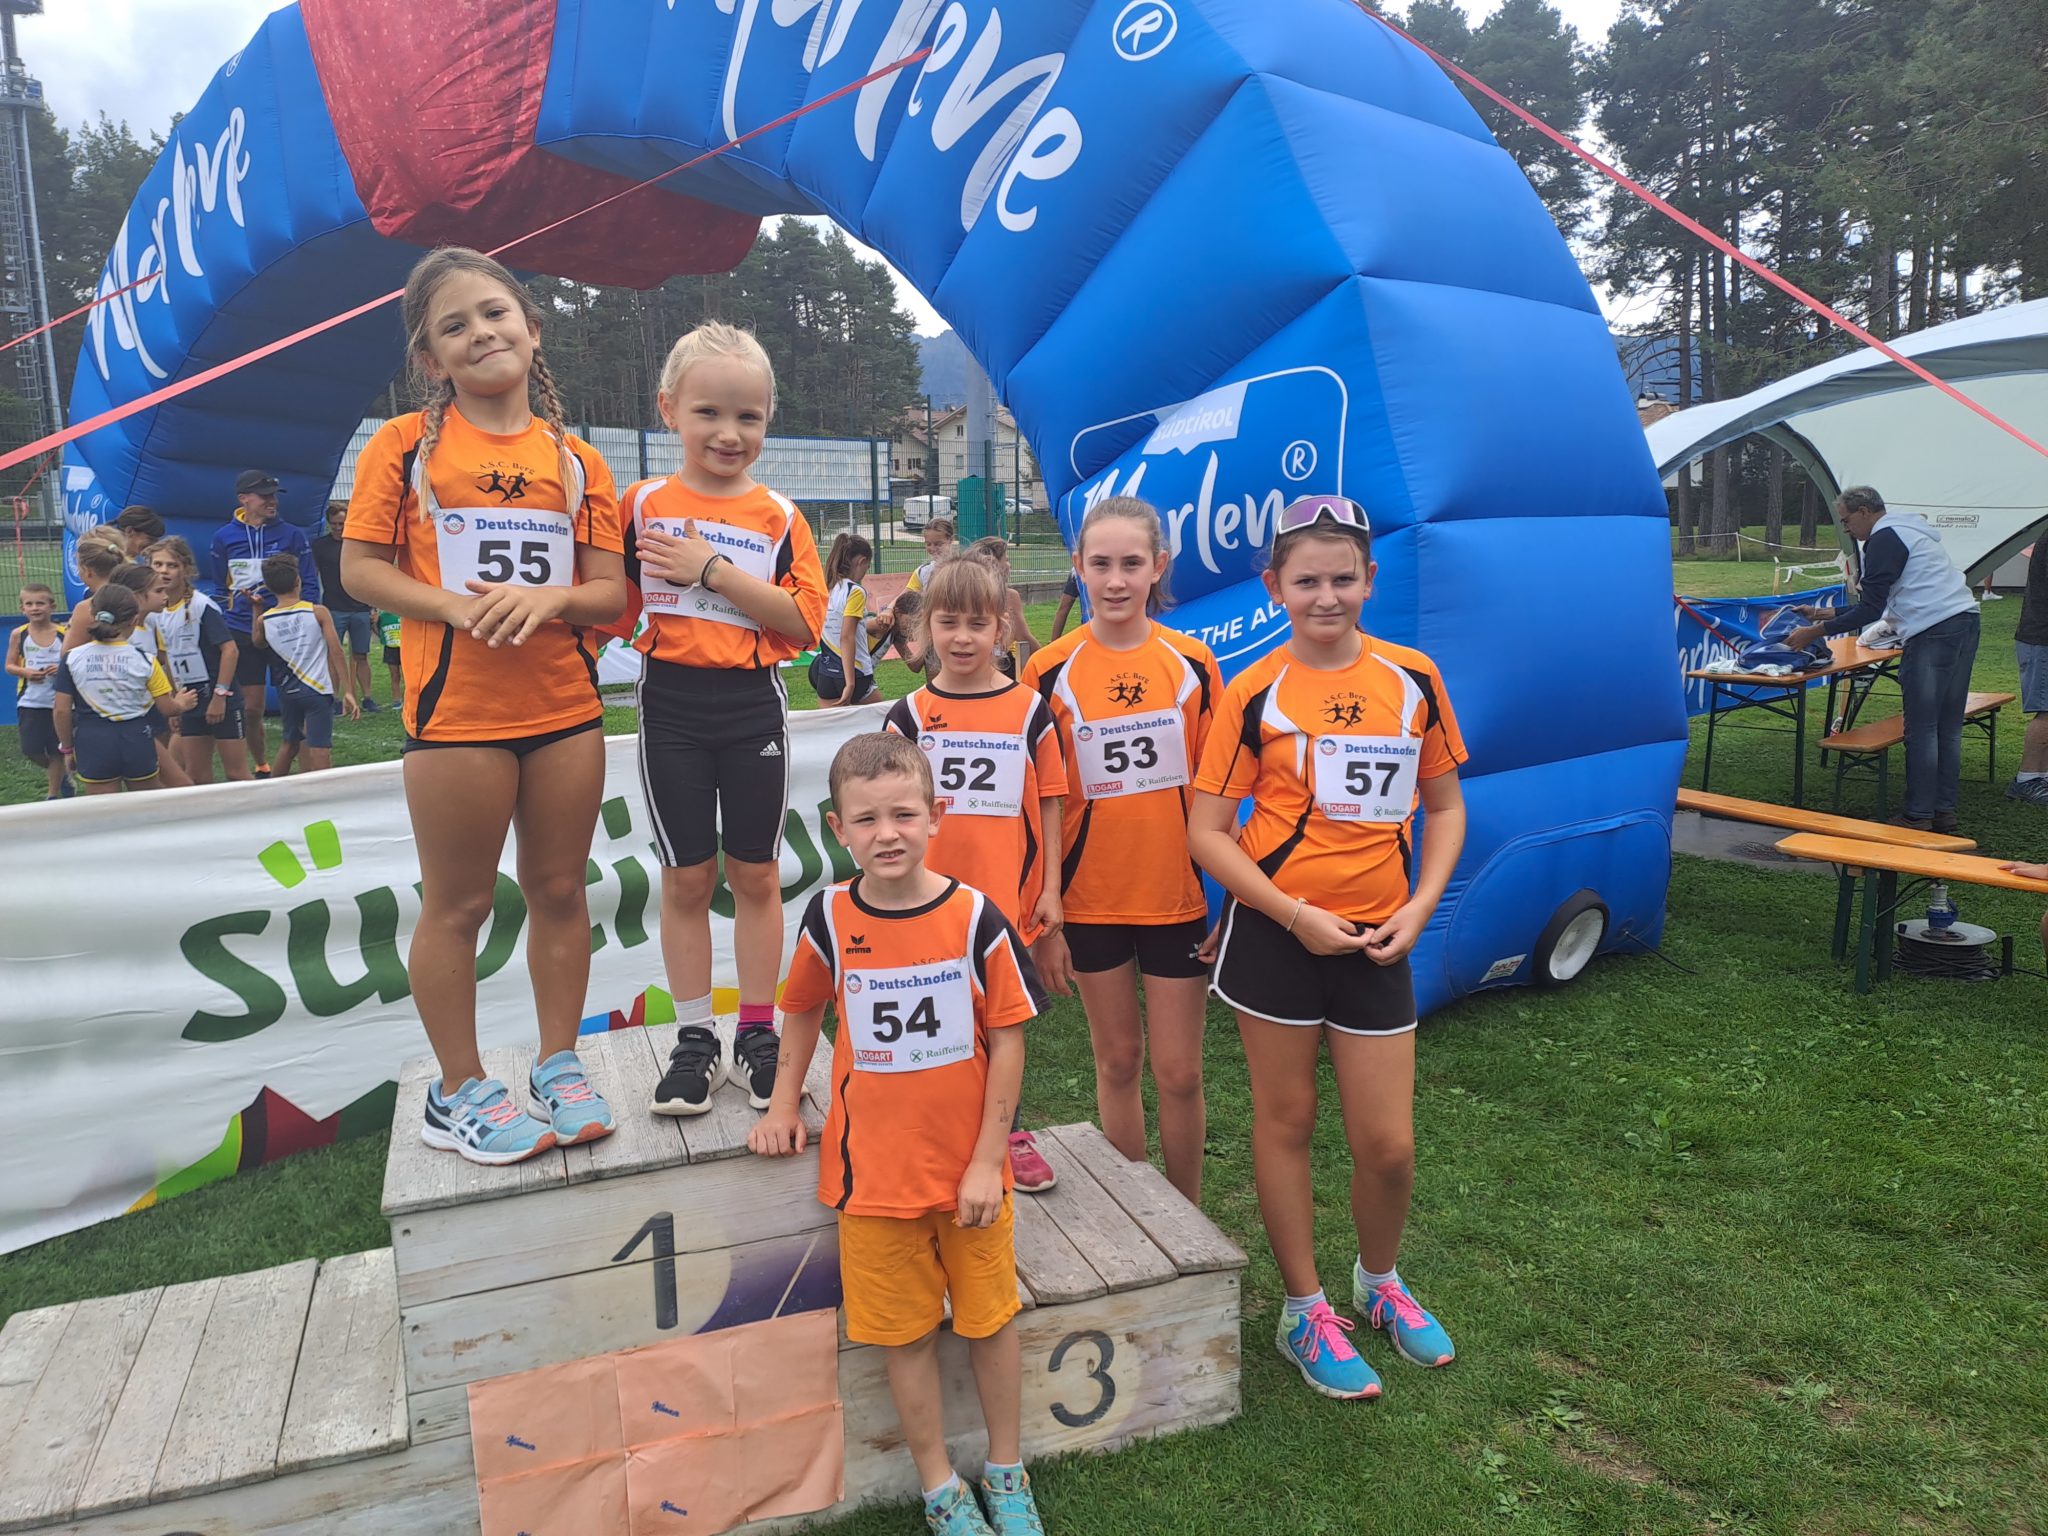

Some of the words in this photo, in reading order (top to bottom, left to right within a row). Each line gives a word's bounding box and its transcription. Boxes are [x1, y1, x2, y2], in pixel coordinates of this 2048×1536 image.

[512, 462, 536, 475] Berg
[475, 518, 568, 536] Deutschnofen
[672, 527, 765, 553] Detschnofen
[477, 540, 551, 584] 55
[1201, 616, 1243, 645] THE
[1133, 672, 1150, 684] Berg
[1349, 691, 1367, 702] Berg
[926, 722, 948, 731] erima
[1100, 717, 1175, 736] Deutschnofen
[942, 739, 1020, 751] Deutschnofen
[1345, 743, 1416, 756] Deutschnofen
[1104, 736, 1158, 774] 53
[939, 757, 996, 791] 52
[1345, 761, 1400, 797] 57
[981, 800, 1017, 809] Raiffeisen
[846, 946, 871, 954] erima
[869, 970, 962, 991] Deutschnofen
[872, 996, 941, 1043] 54
[926, 1043, 970, 1058] Raiffeisen
[611, 1211, 677, 1330] 1
[1048, 1330, 1116, 1428] 3
